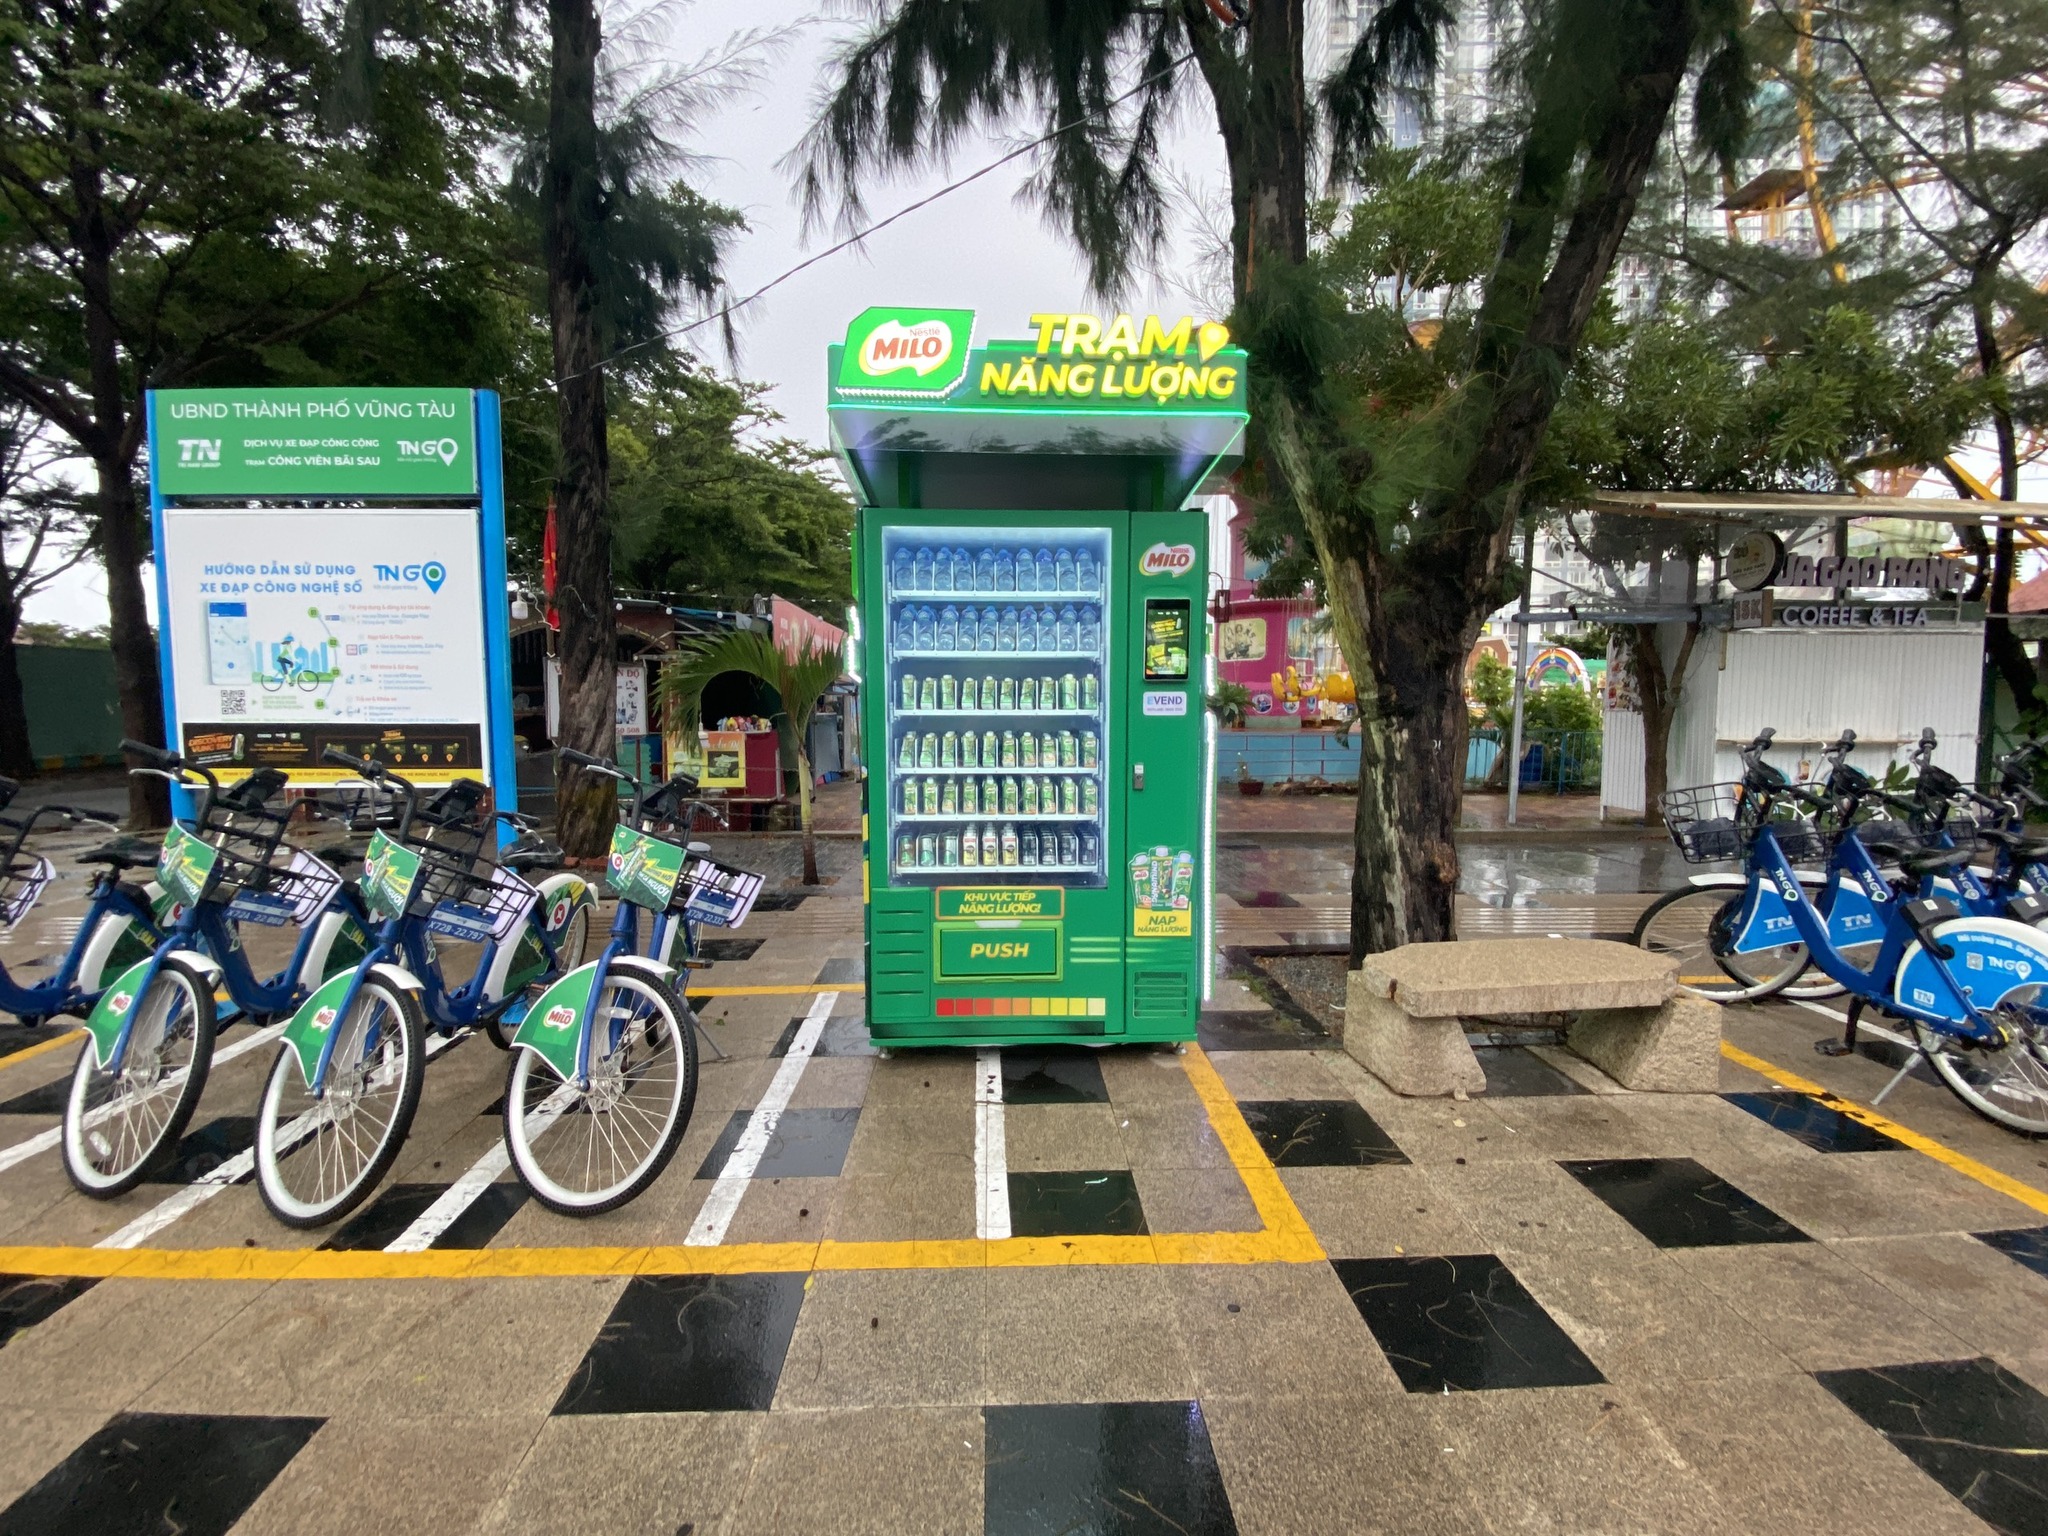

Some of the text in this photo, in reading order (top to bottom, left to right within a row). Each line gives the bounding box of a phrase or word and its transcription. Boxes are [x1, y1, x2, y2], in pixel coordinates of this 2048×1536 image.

[1029, 313, 1193, 361] TRẠM
[873, 337, 942, 360] MILO
[981, 357, 1237, 405] NĂNG LƯỢNG
[171, 397, 455, 418] UBND THÀNH PHỐ VŨNG TÀU
[178, 439, 222, 461] TN
[285, 439, 297, 448] XE
[268, 455, 301, 466] CÔNG
[304, 455, 331, 466] VIÊN
[357, 457, 380, 466] SAU
[1147, 553, 1190, 567] MILO
[315, 565, 355, 577] DỤNG
[200, 583, 216, 593] XE
[221, 583, 249, 595] ĐẠP
[254, 580, 296, 593] CÔNG
[1782, 605, 1928, 627] COFFEE & TEA
[964, 892, 988, 902] KHU
[1013, 890, 1036, 902] TIẾP
[959, 902, 1041, 915] NĂNG LƯỢNG!
[1841, 913, 1871, 928] TN
[970, 943, 1029, 958] PUSH
[548, 1010, 572, 1025] MILO
